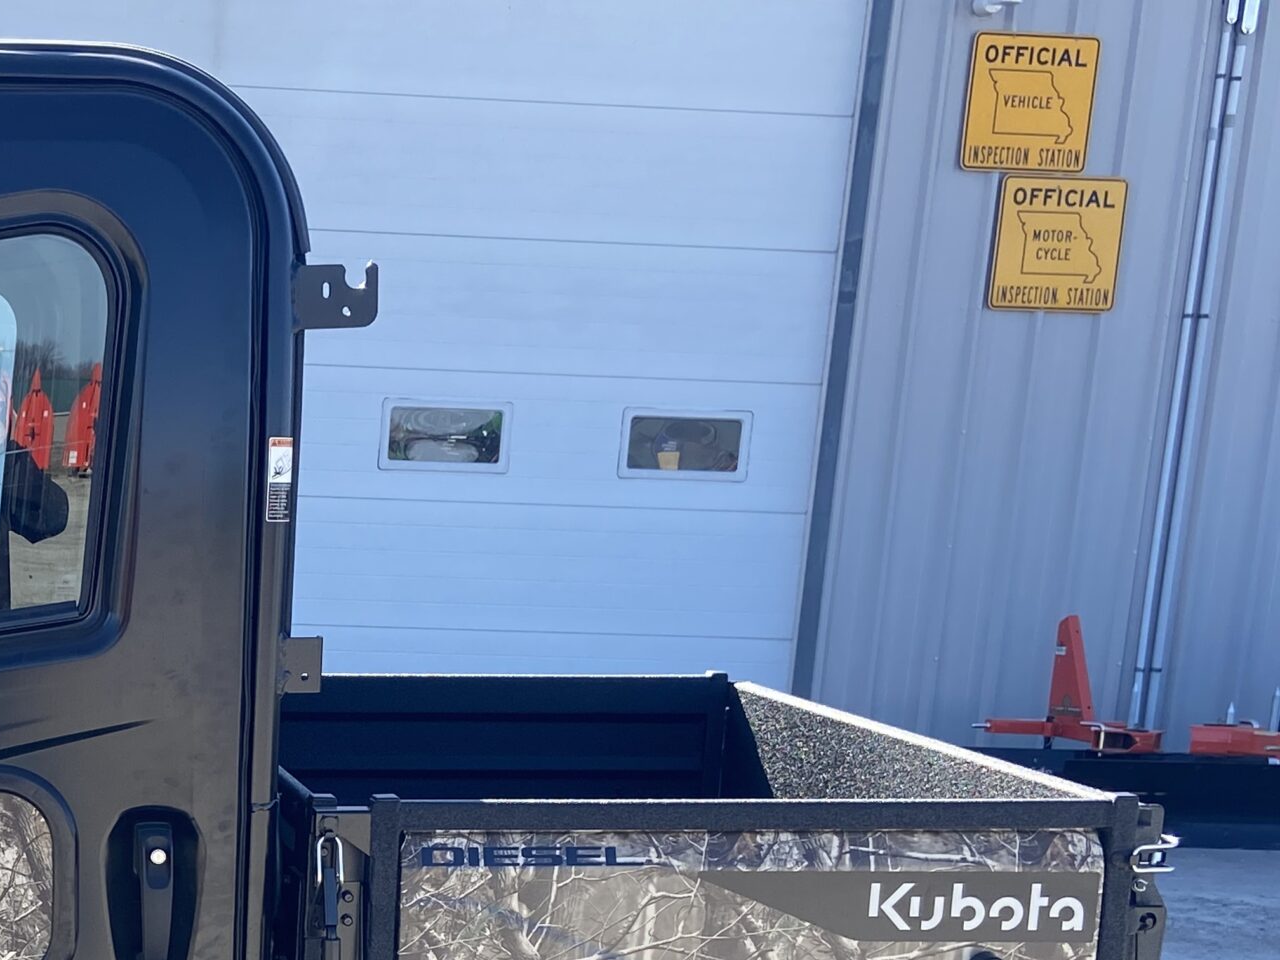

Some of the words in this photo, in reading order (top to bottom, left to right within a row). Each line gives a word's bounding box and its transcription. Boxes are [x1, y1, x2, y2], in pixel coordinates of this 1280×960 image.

[984, 44, 1088, 68] OFFICIAL
[1003, 95, 1053, 110] VEHICLE
[968, 145, 1029, 167] INSPECTION
[1037, 148, 1081, 169] STATION
[1012, 187, 1116, 209] OFFICIAL
[1032, 229, 1078, 243] MOTOR-
[1036, 247, 1071, 261] CYCLE
[995, 285, 1059, 305] INSPECTION
[1066, 287, 1109, 307] STATION
[421, 845, 646, 867] DIESEL
[867, 882, 1085, 932] Kubota
